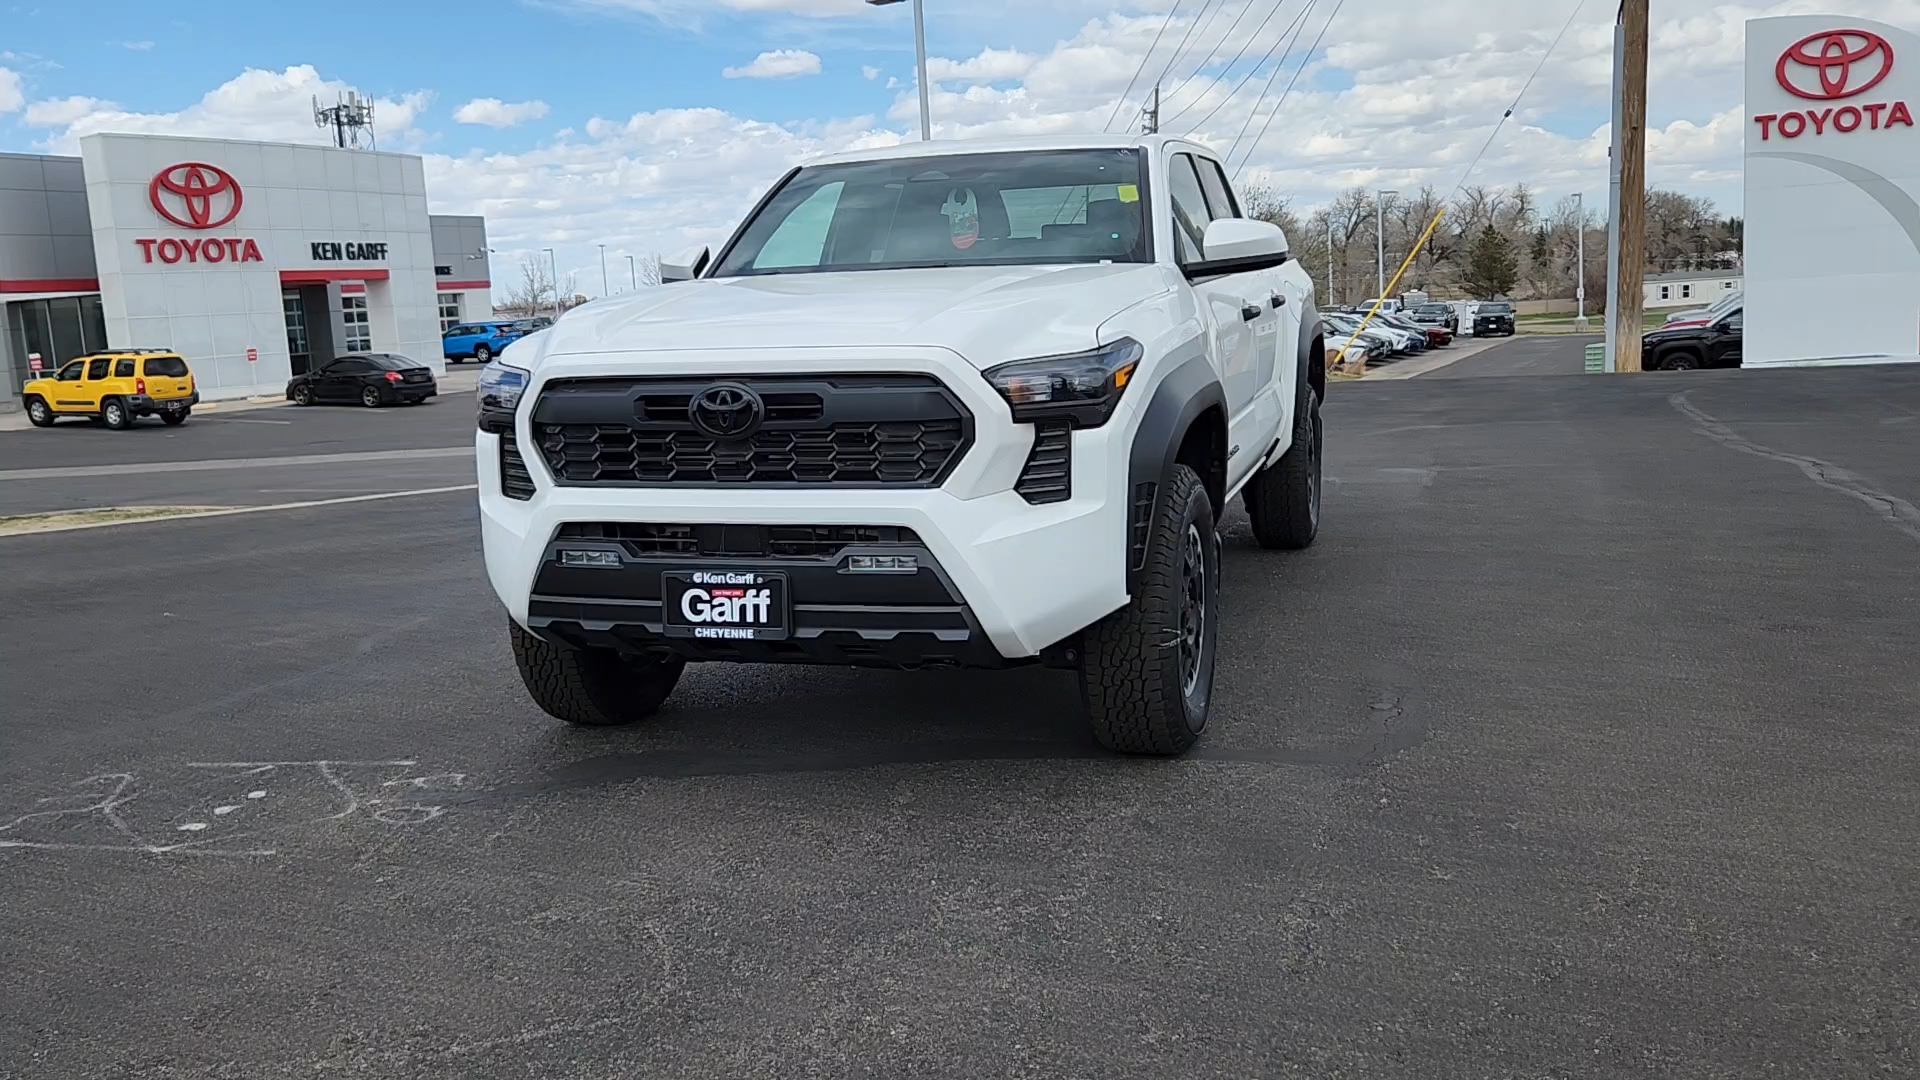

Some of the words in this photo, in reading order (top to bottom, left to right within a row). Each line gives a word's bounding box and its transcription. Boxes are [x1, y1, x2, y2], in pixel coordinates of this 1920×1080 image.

[1754, 101, 1914, 141] TOYOTA
[135, 237, 264, 264] TOYOTA
[311, 242, 343, 261] KEN
[345, 242, 388, 261] GARFF
[703, 572, 726, 584] Ken
[726, 573, 755, 585] Garff
[681, 588, 771, 624] Garff
[694, 628, 755, 640] CHEYENNE
